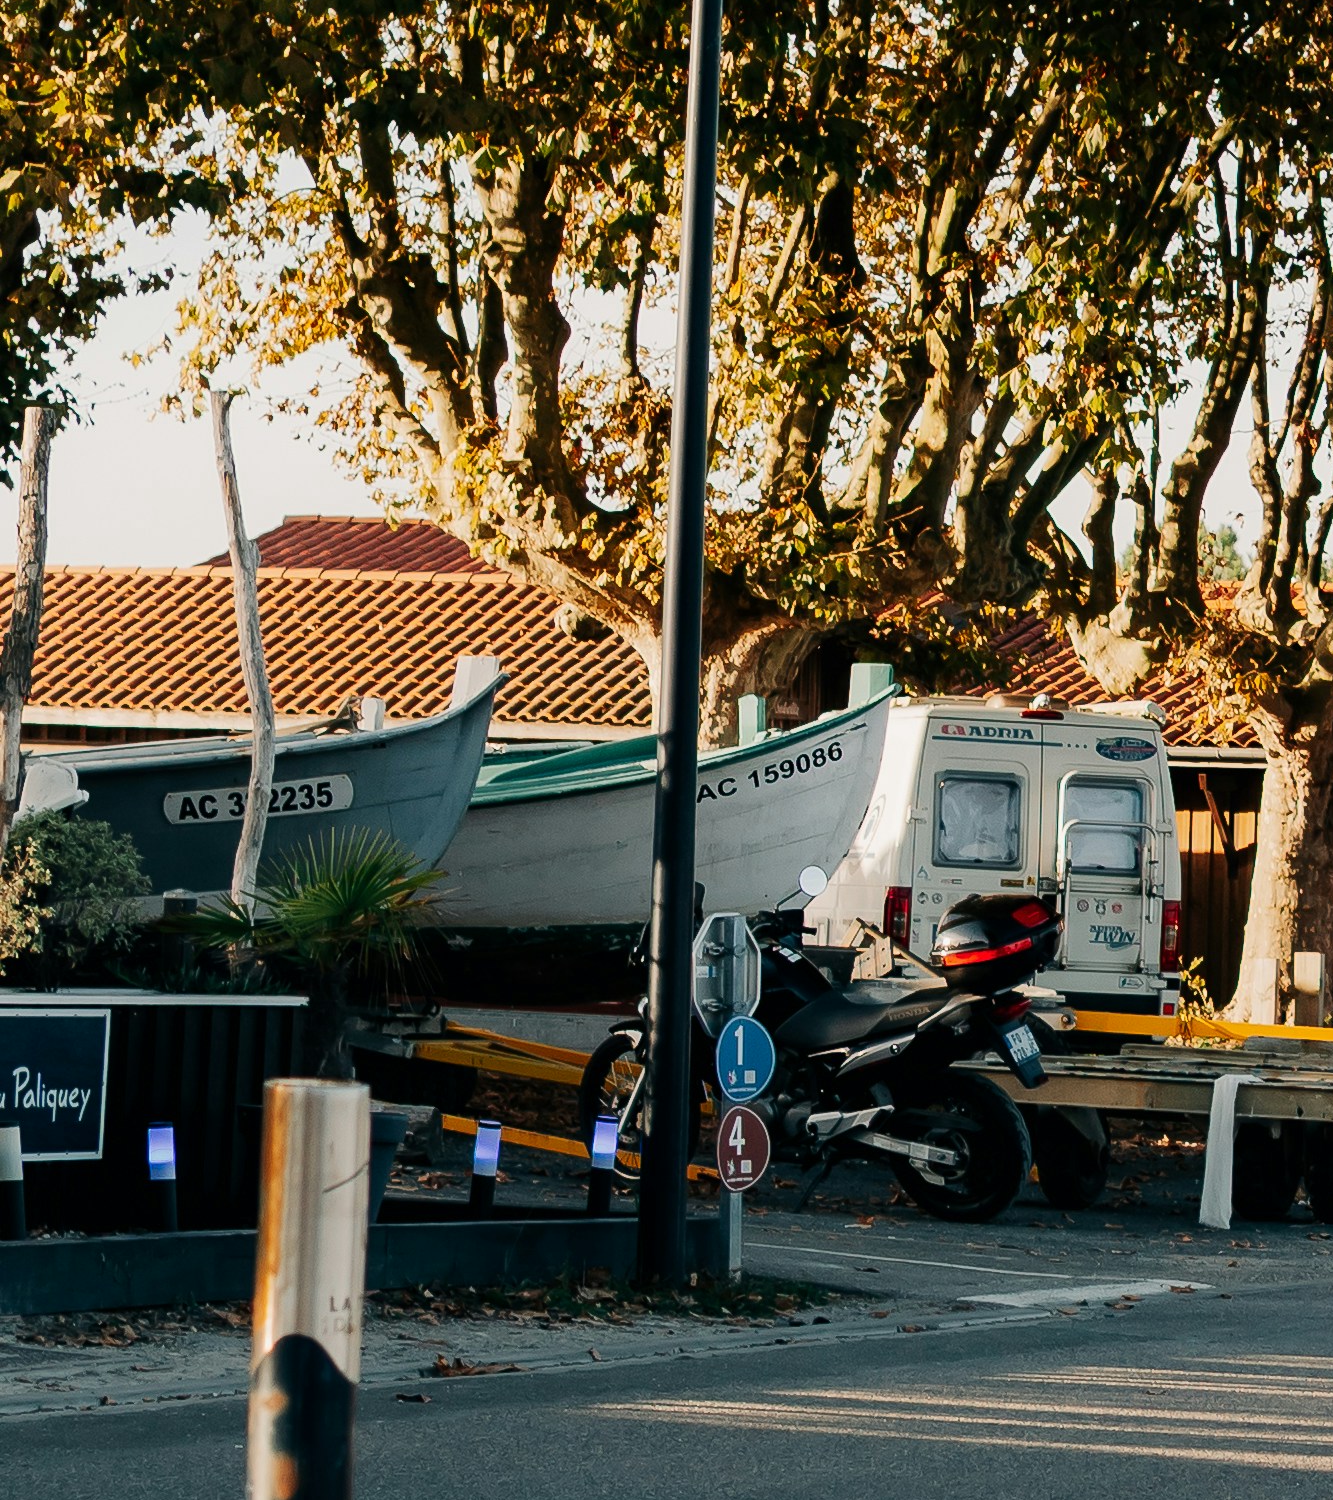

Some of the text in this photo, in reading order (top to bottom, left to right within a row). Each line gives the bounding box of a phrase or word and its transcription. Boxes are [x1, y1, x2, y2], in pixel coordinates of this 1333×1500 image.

[969, 725, 1034, 740] ADRIA
[696, 741, 843, 803] AC 159086
[178, 781, 333, 821] AC 32235
[734, 1024, 744, 1066] 1
[12, 1066, 91, 1122] Paliquey
[728, 1115, 746, 1156] 4
